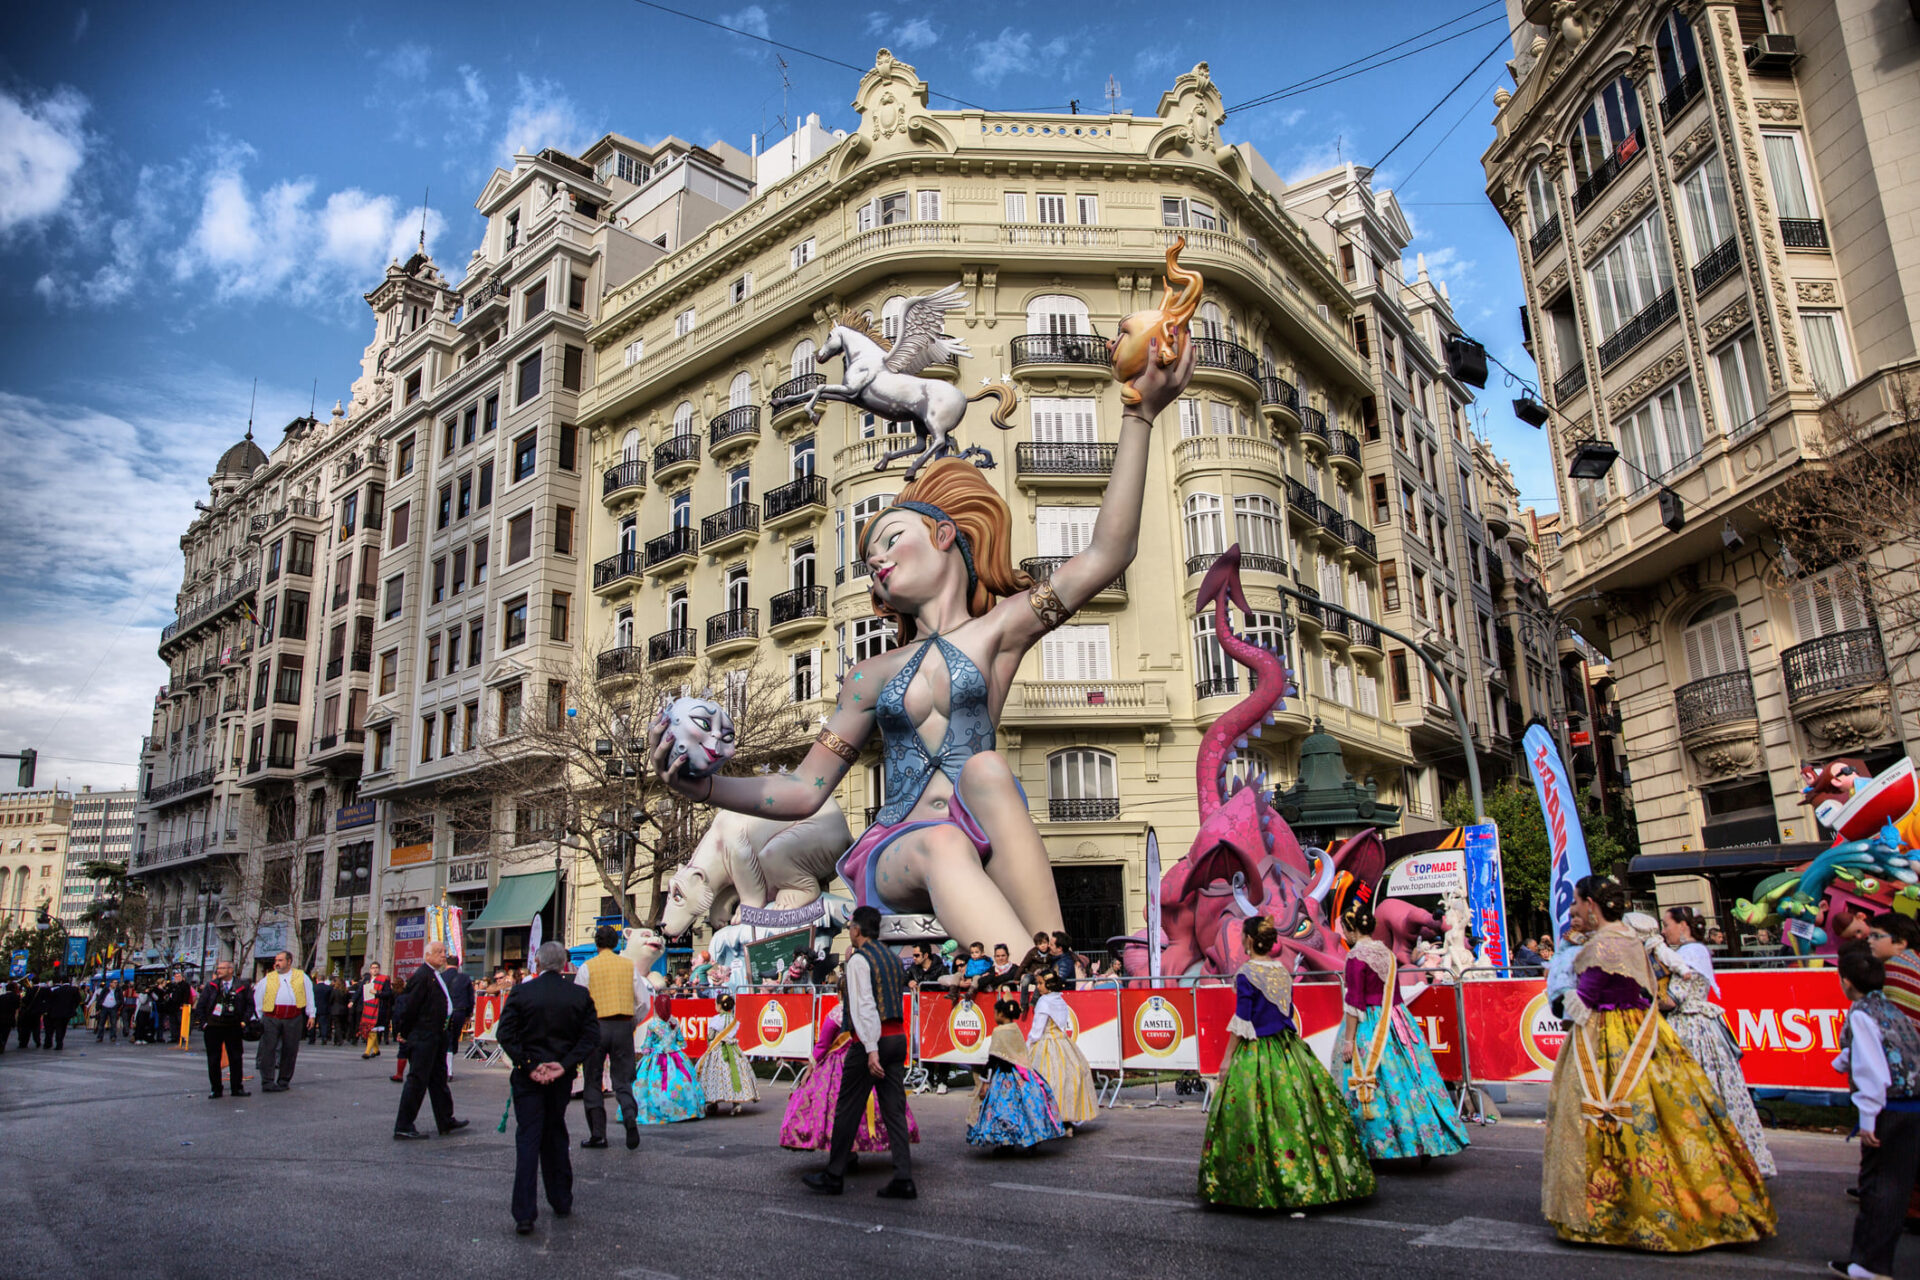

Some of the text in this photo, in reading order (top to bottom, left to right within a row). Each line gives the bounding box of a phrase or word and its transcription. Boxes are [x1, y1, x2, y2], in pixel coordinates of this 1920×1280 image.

[449, 860, 488, 883] PASAJE REX
[1414, 861, 1457, 874] TOPMADE
[742, 908, 769, 924] ESCUELA
[780, 900, 823, 924] ASTRONOMIA
[956, 1020, 978, 1028] AMSTEL
[1144, 1020, 1173, 1029] AMSTEL
